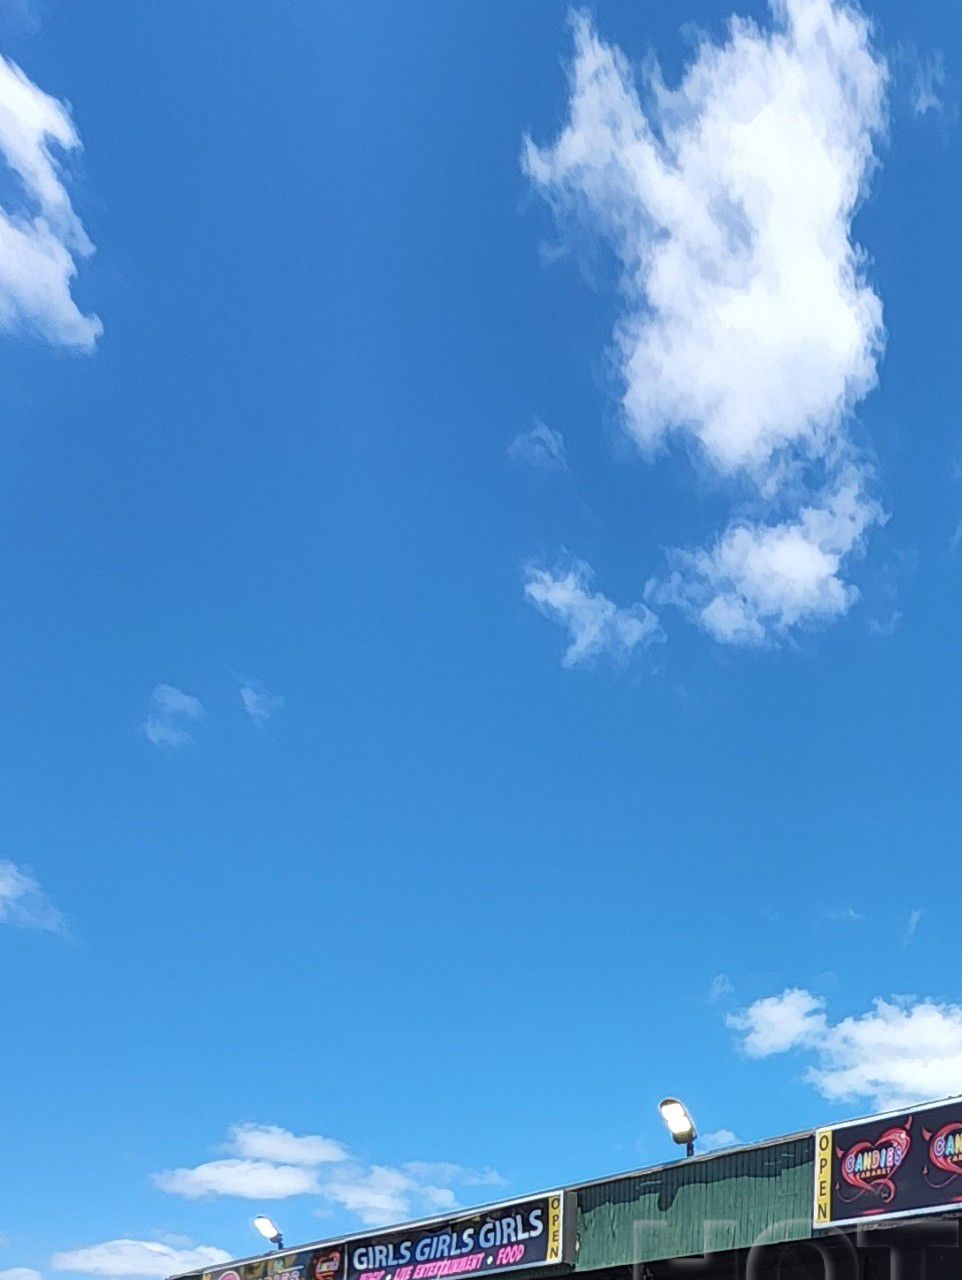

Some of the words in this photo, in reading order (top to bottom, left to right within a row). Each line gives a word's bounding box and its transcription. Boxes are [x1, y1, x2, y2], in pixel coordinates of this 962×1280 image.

[818, 1134, 830, 1220] OPEN
[845, 1145, 902, 1173] CANDIES
[353, 1241, 412, 1270] GIRLS
[415, 1228, 475, 1262] GIRLS
[479, 1209, 544, 1248] GIRLS
[495, 1244, 525, 1266] FOOD
[551, 1197, 560, 1259] OPEN
